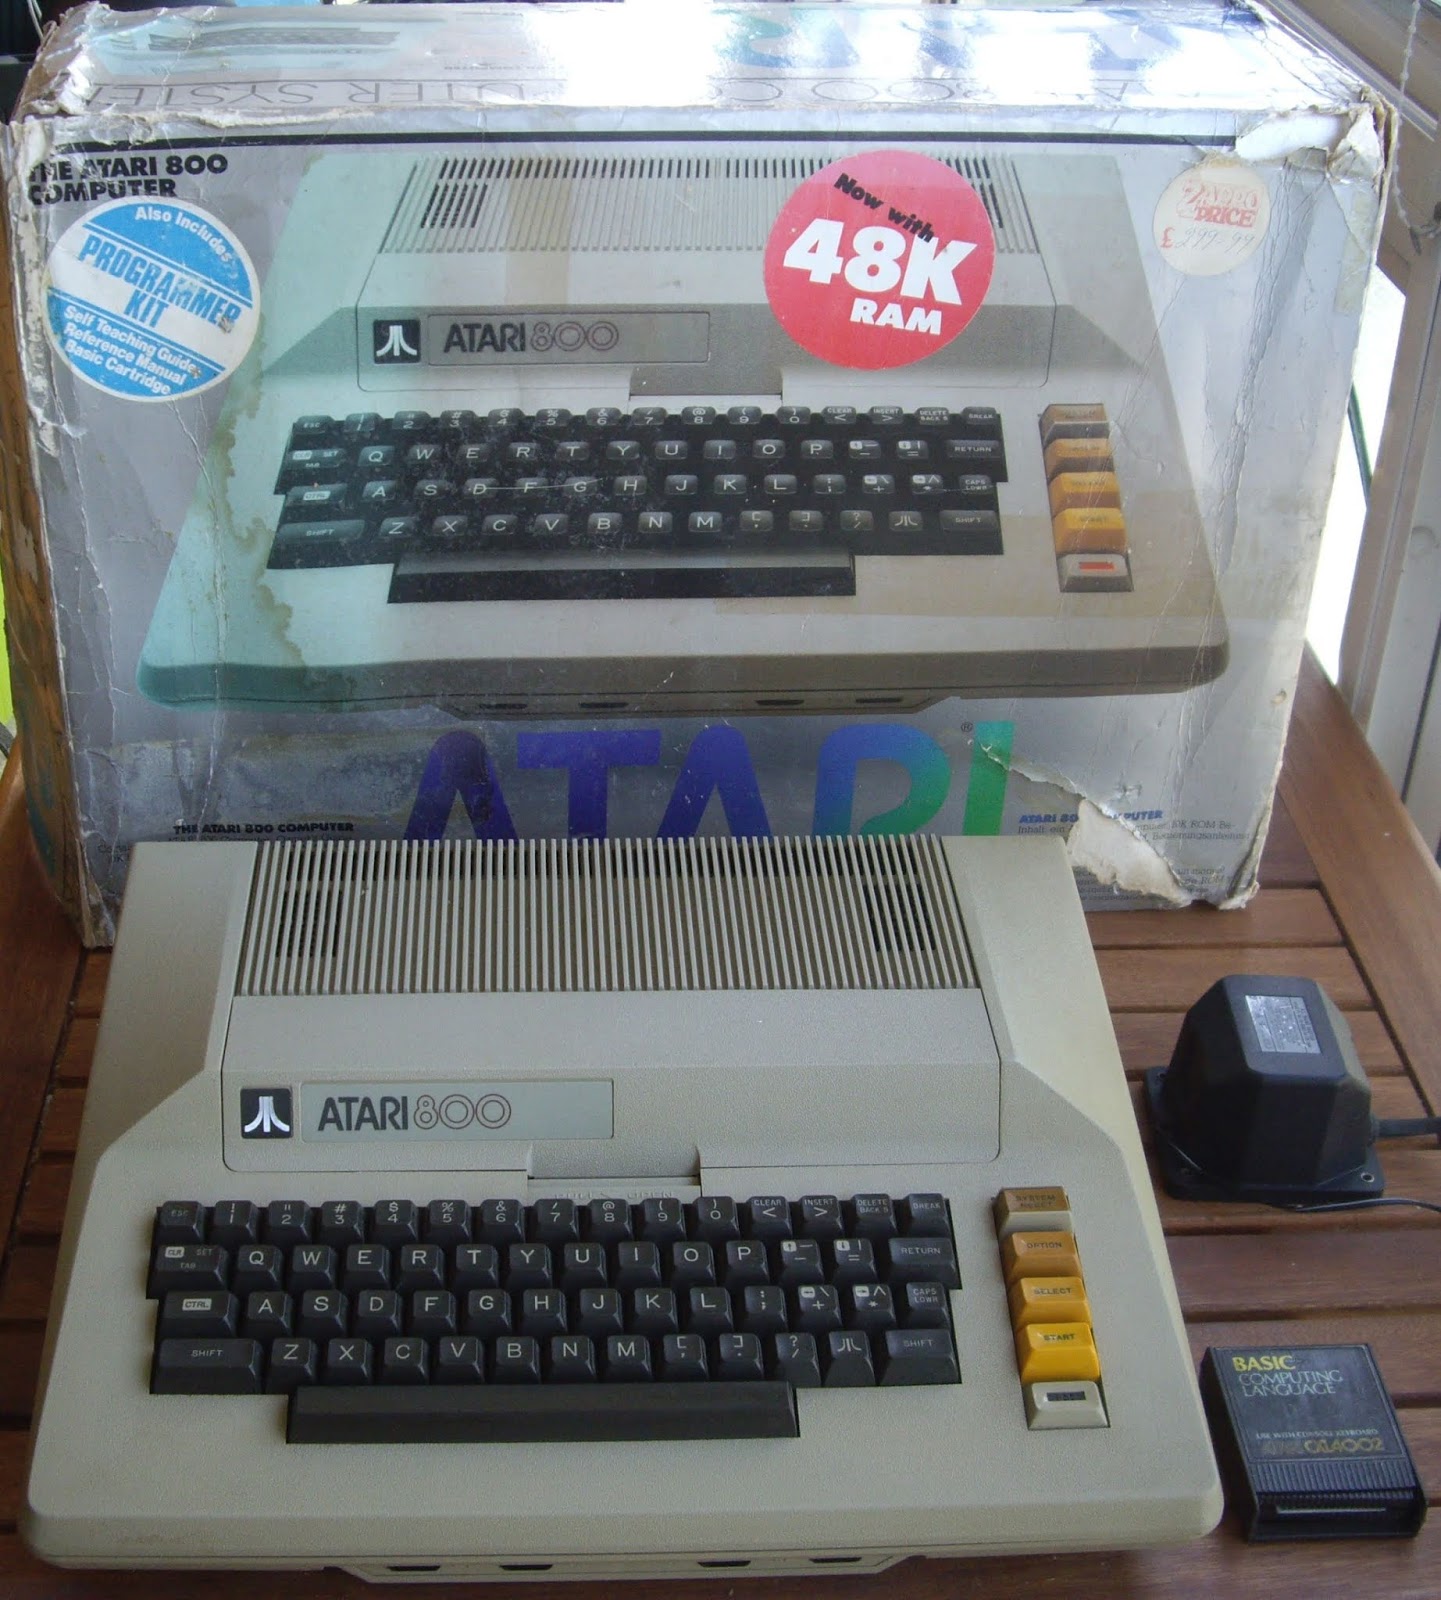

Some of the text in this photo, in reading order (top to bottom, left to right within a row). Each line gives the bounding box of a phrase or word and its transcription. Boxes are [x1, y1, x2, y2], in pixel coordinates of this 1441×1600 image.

[29, 153, 228, 181] THE ATARI 800
[28, 177, 177, 206] COMPUTER
[833, 172, 936, 243] Now with
[135, 206, 172, 222] Also
[1194, 206, 1255, 228] PRICE
[783, 217, 978, 306] 48K
[79, 234, 242, 333] PROGRAMMER
[123, 289, 169, 328] KIT
[850, 297, 942, 335] RAM
[64, 305, 95, 327] Self
[96, 317, 157, 358] Teaching
[443, 321, 620, 352] ATARI 800
[64, 322, 187, 386] Reference Manual
[65, 339, 171, 395] Basic Cartridge
[416, 448, 434, 459] W
[466, 447, 479, 458] E
[517, 447, 530, 457] R
[567, 446, 579, 457] T
[617, 445, 630, 456] Y
[665, 444, 678, 455] U
[762, 444, 776, 455] O
[369, 451, 383, 462] Q
[424, 484, 437, 495] S
[473, 484, 487, 494] D
[524, 482, 537, 492] F
[571, 481, 587, 492] G
[624, 480, 637, 490] H
[676, 479, 687, 490] J
[724, 480, 736, 491] K
[774, 480, 786, 490] L
[373, 486, 385, 497] A
[443, 521, 457, 531] X
[493, 519, 506, 530] C
[545, 519, 559, 530] V
[598, 517, 610, 529] B
[649, 516, 662, 527] N
[698, 516, 713, 527] M
[389, 522, 404, 534] Z
[403, 720, 1016, 841] ATARI
[1019, 814, 1057, 823] ATARI
[1191, 820, 1216, 829] ROM
[173, 822, 354, 834] THE ATARI 800 COMPUTER
[317, 1093, 512, 1131] ATARI 800
[857, 1199, 887, 1207] DELETE
[281, 1214, 292, 1225] 2
[335, 1215, 344, 1224] 3
[387, 1213, 398, 1223] 4
[443, 1213, 452, 1223] 5
[496, 1213, 505, 1222] 6
[551, 1213, 560, 1222] 7
[605, 1213, 614, 1222] 8
[658, 1213, 667, 1221] 9
[358, 1250, 371, 1264] E
[467, 1250, 481, 1264] T
[521, 1250, 534, 1263] Y
[576, 1249, 589, 1262] U
[684, 1249, 698, 1261] O
[738, 1247, 751, 1260] P
[901, 1247, 941, 1255] RETURN
[249, 1251, 263, 1265] Q
[303, 1252, 321, 1265] W
[412, 1251, 426, 1264] R
[913, 1288, 937, 1296] CAPS
[1034, 1287, 1071, 1295] SELECT
[185, 1301, 208, 1309] CTRL
[259, 1299, 272, 1313] A
[314, 1297, 328, 1311] S
[370, 1297, 383, 1311] D
[425, 1297, 438, 1311] F
[480, 1296, 493, 1310] G
[535, 1296, 548, 1309] H
[593, 1295, 603, 1309] J
[646, 1295, 660, 1308] K
[701, 1294, 715, 1307] L
[1044, 1333, 1075, 1341] START
[563, 1343, 577, 1356] N
[618, 1342, 634, 1356] M
[903, 1339, 933, 1348] SHIFT
[191, 1349, 223, 1358] SHIFT
[284, 1344, 298, 1359] Z
[340, 1346, 354, 1360] X
[396, 1345, 409, 1359] C
[451, 1343, 465, 1357] V
[508, 1343, 521, 1357] B
[1232, 1355, 1296, 1372] BASIC
[1239, 1369, 1344, 1386] COMPUTING
[1241, 1382, 1336, 1397] LANGUAGE
